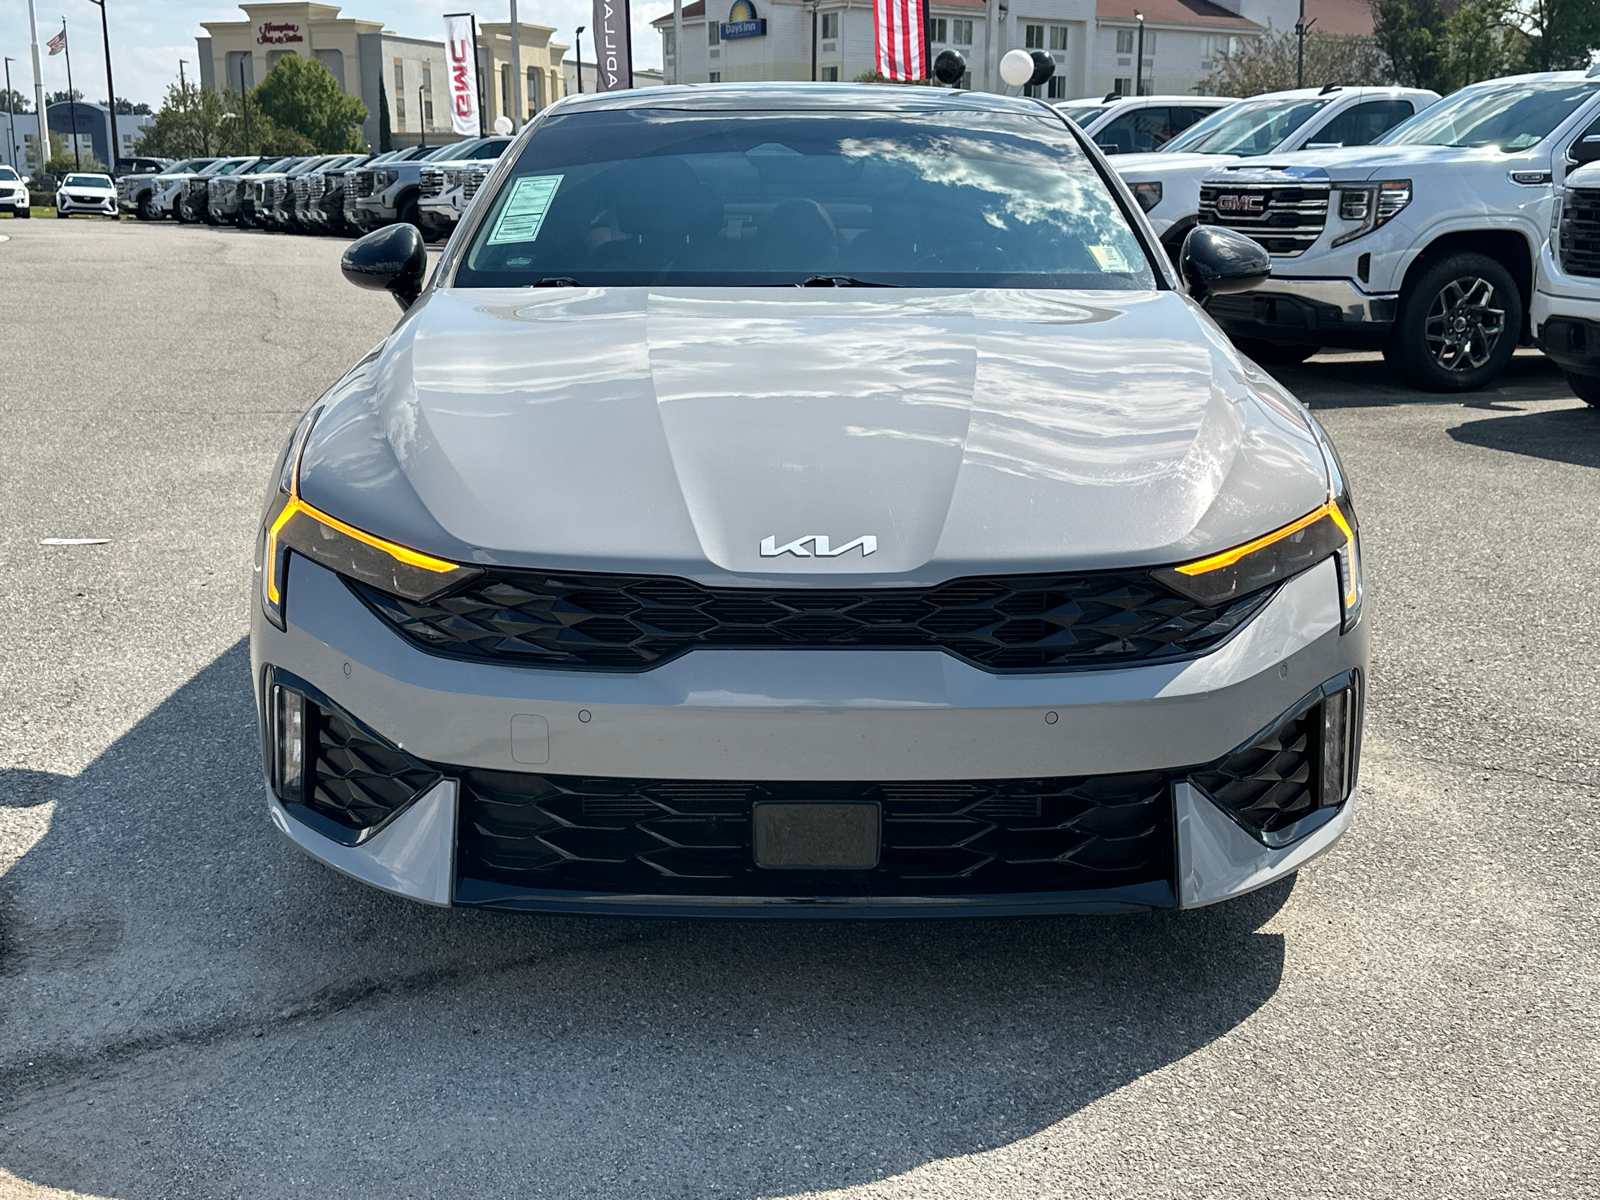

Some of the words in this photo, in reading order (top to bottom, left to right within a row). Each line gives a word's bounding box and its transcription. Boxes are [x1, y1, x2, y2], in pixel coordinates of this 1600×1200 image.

[725, 24, 743, 34] Days
[743, 22, 756, 32] Inn
[1218, 195, 1265, 211] GMC
[760, 534, 877, 557] KIA
